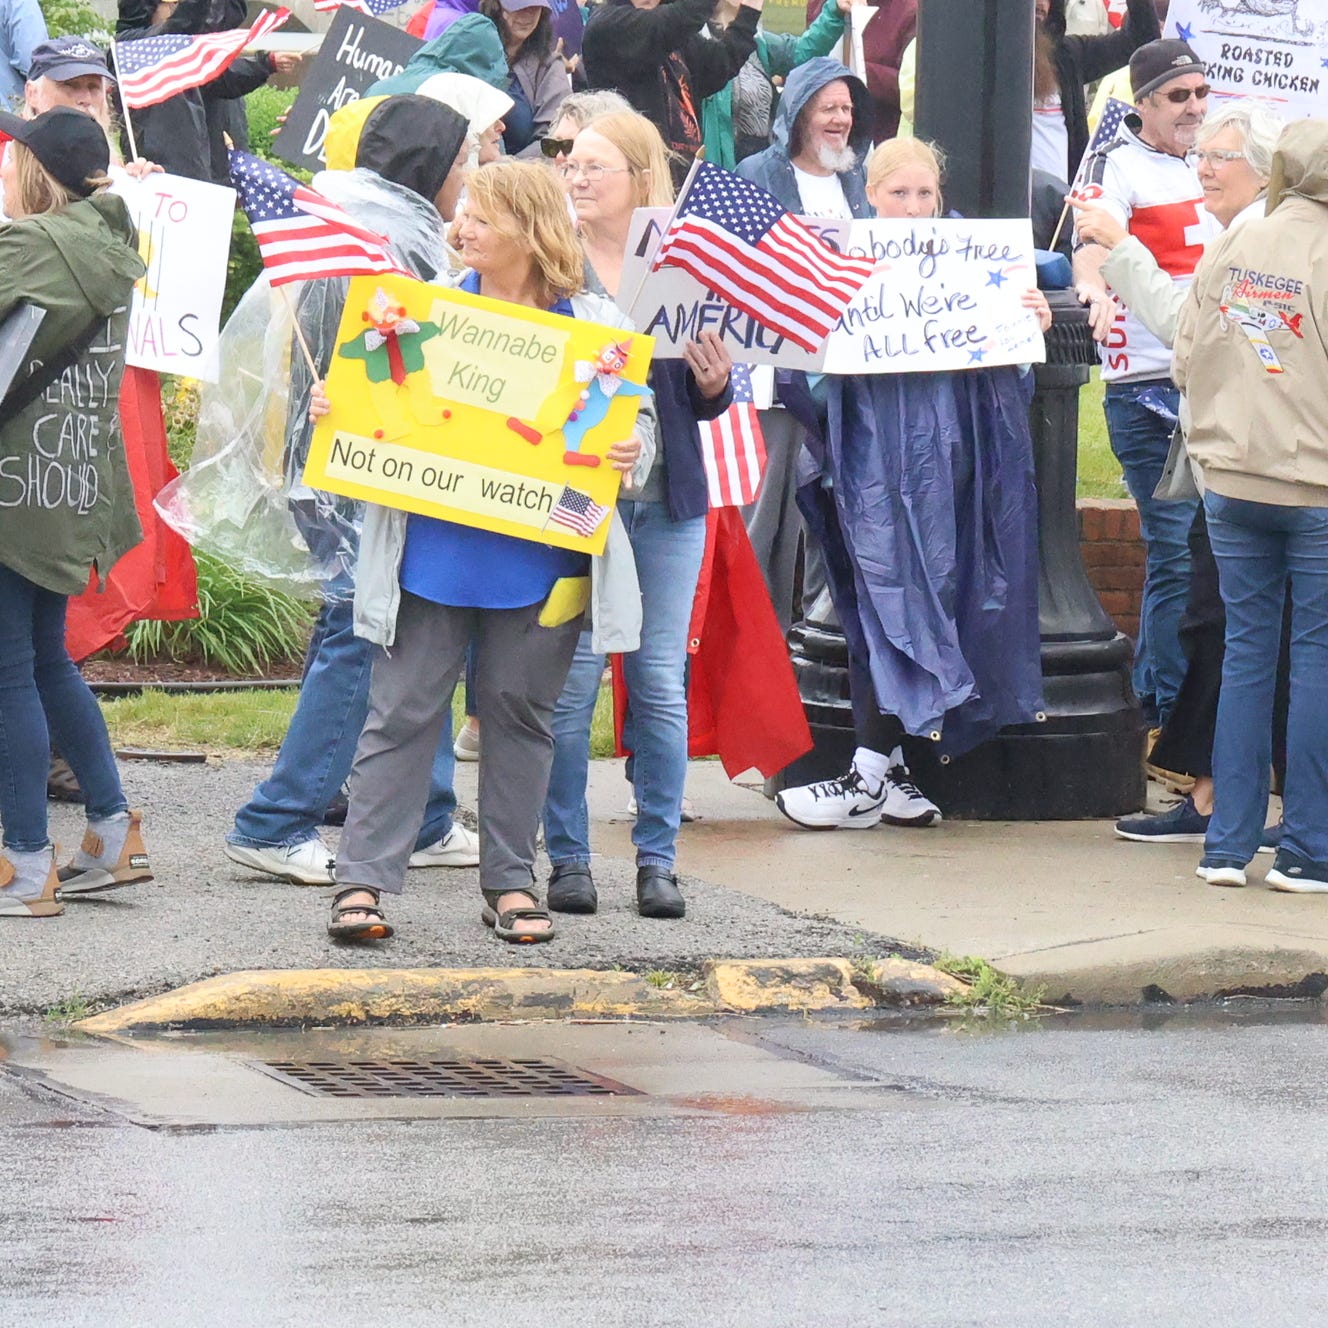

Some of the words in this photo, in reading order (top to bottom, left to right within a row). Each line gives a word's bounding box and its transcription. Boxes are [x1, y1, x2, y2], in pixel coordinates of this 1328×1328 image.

[1221, 42, 1294, 69] ROASTED
[1252, 69, 1320, 96] CHICKEN
[155, 192, 188, 223] TO
[1228, 266, 1304, 295] TUSKEGEE
[1232, 278, 1296, 300] Airmen
[437, 310, 558, 365] Wannabe
[864, 333, 920, 363] ALL
[447, 360, 507, 404] King
[33, 413, 99, 461] CARE
[330, 438, 377, 473] Not
[382, 456, 413, 483] on
[421, 467, 465, 493] our
[480, 477, 554, 514] watch
